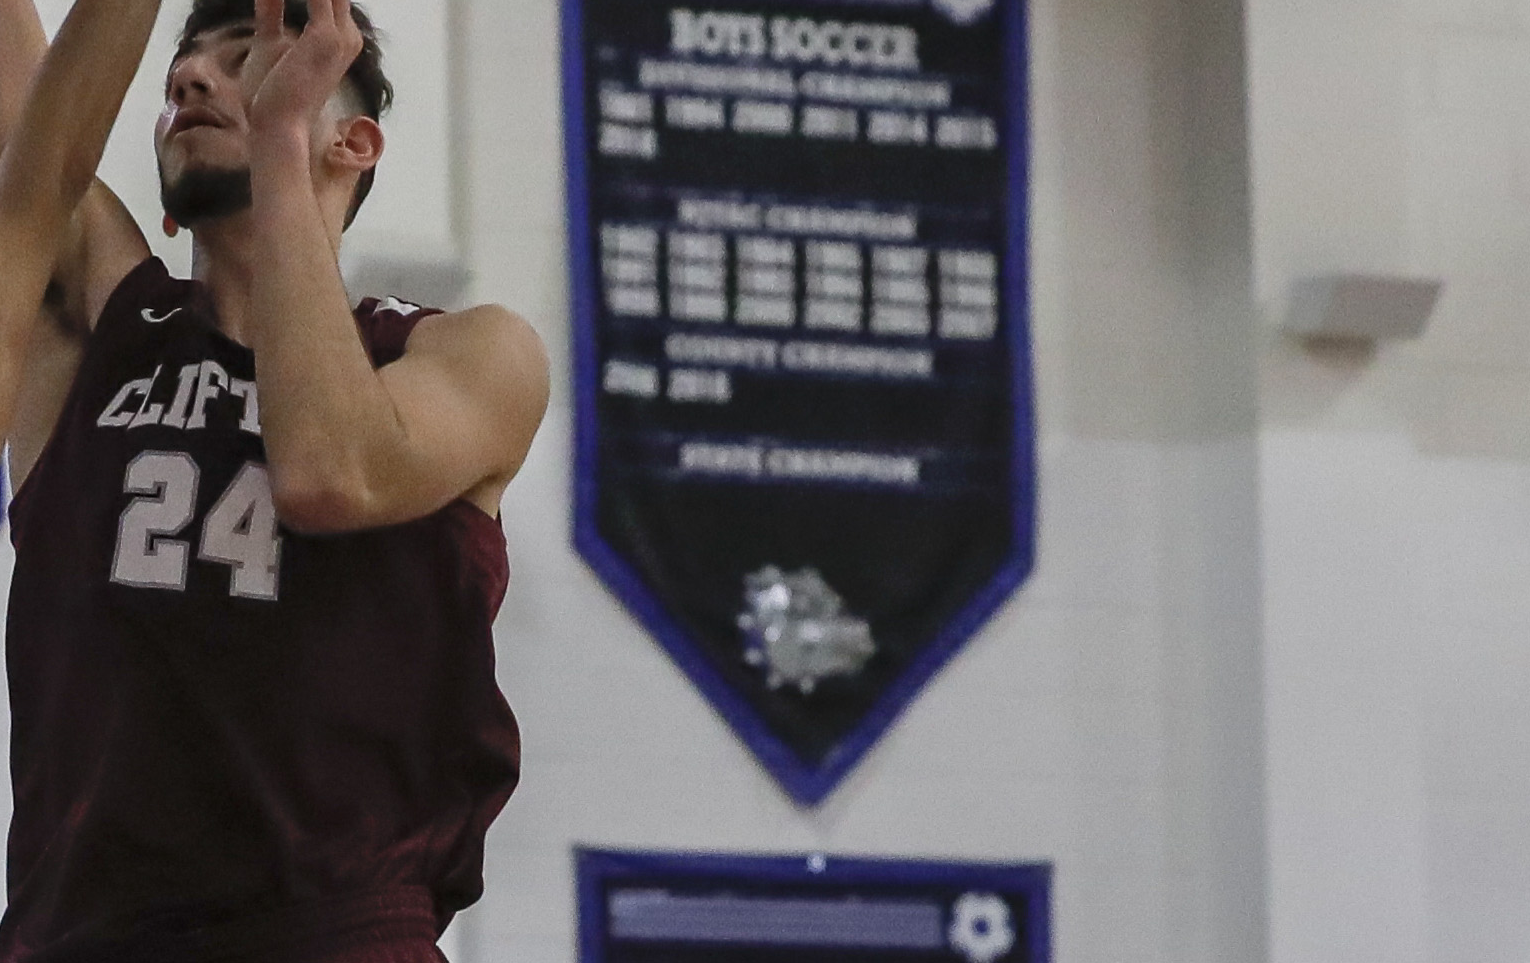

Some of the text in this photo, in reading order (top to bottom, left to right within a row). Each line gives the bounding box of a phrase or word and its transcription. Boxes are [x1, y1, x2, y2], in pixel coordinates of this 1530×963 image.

[670, 8, 919, 71] BOYS SOCCER
[96, 360, 261, 435] CLIFT
[109, 449, 280, 602] 24
